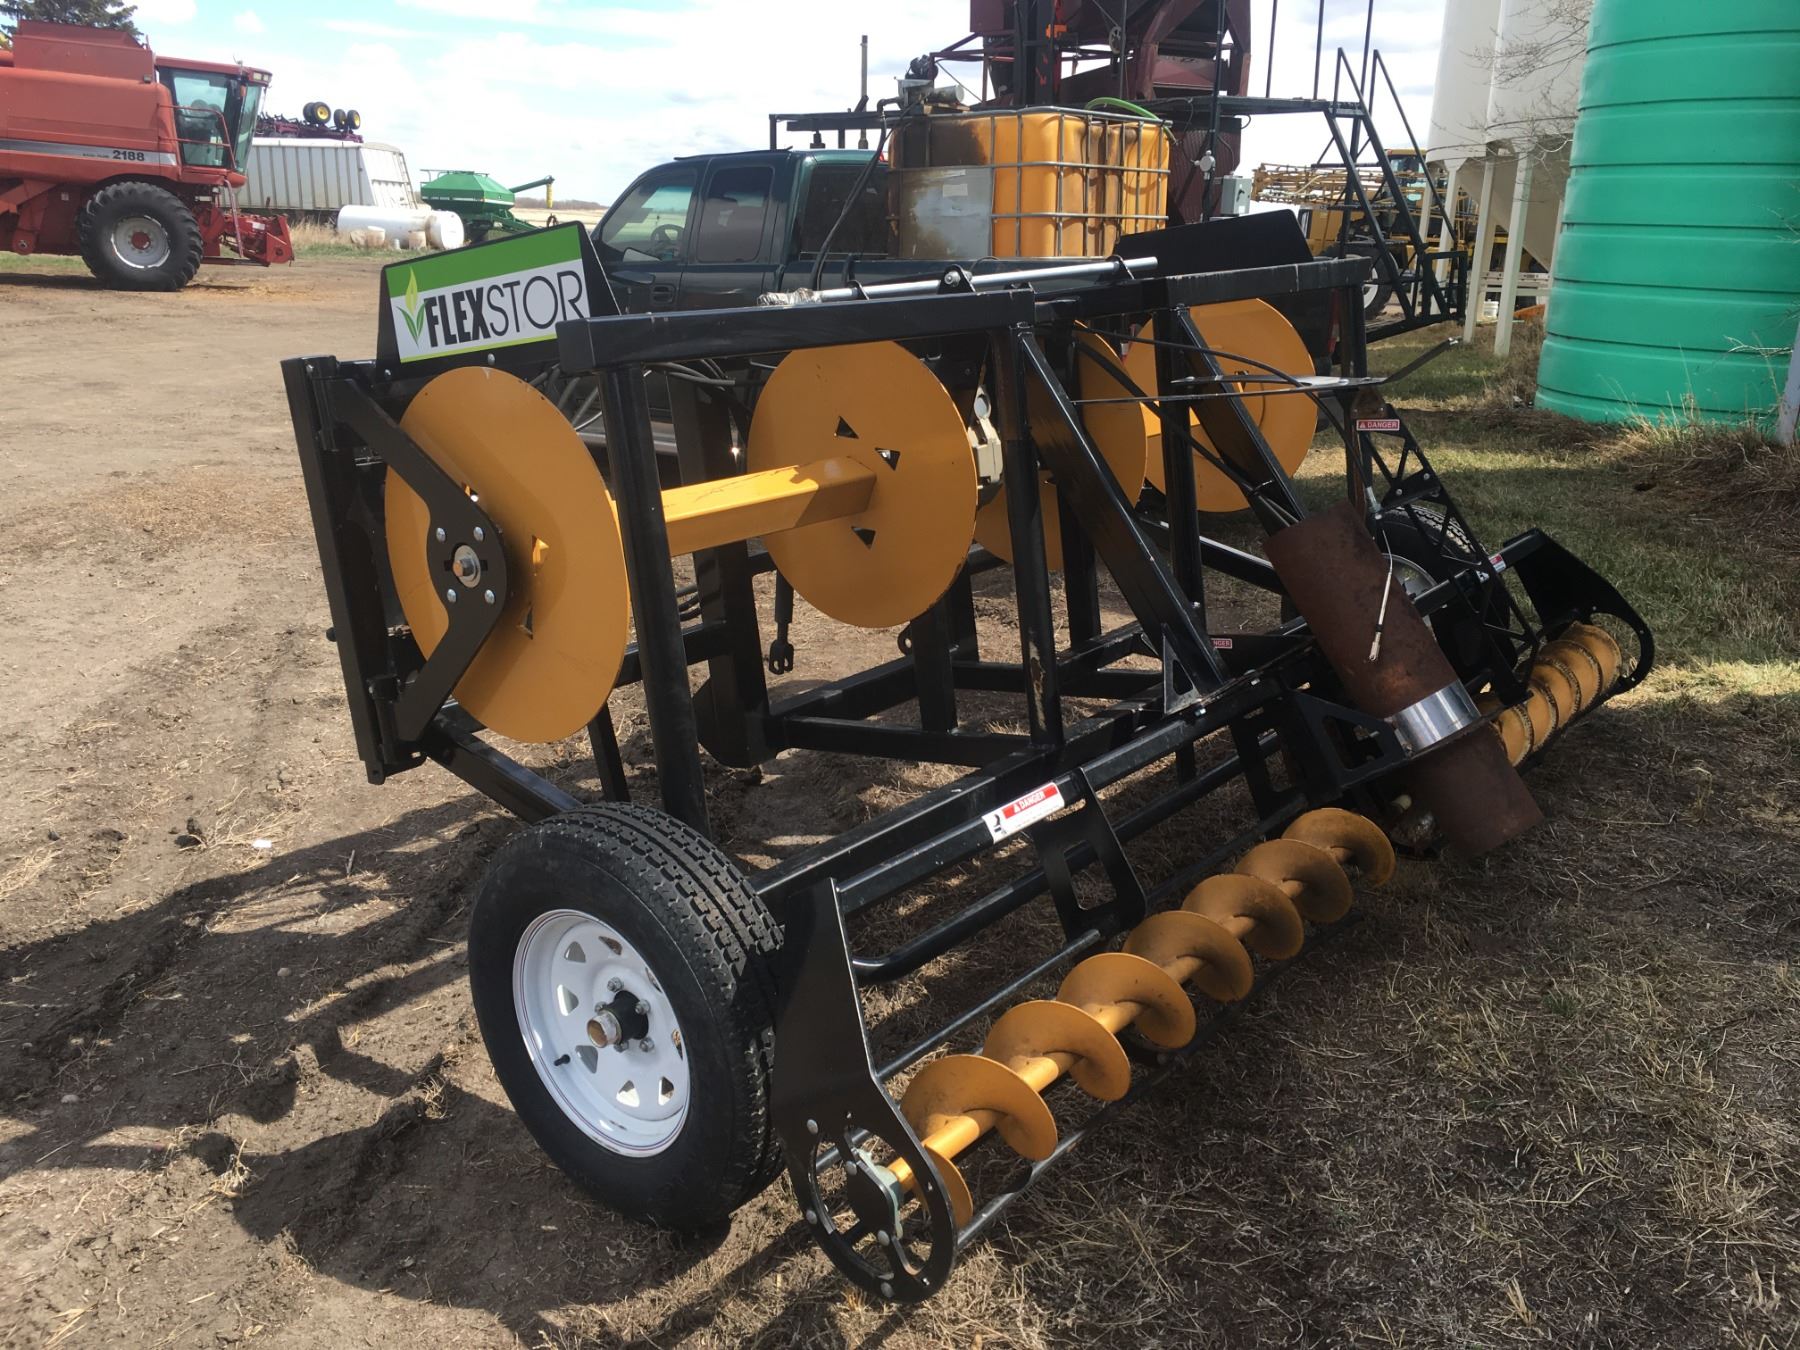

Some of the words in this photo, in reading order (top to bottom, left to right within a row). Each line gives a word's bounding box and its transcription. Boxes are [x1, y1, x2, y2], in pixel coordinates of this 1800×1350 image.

[112, 150, 145, 161] 2188
[424, 270, 584, 347] FLEXSTOR
[1018, 790, 1046, 809] DANGER
